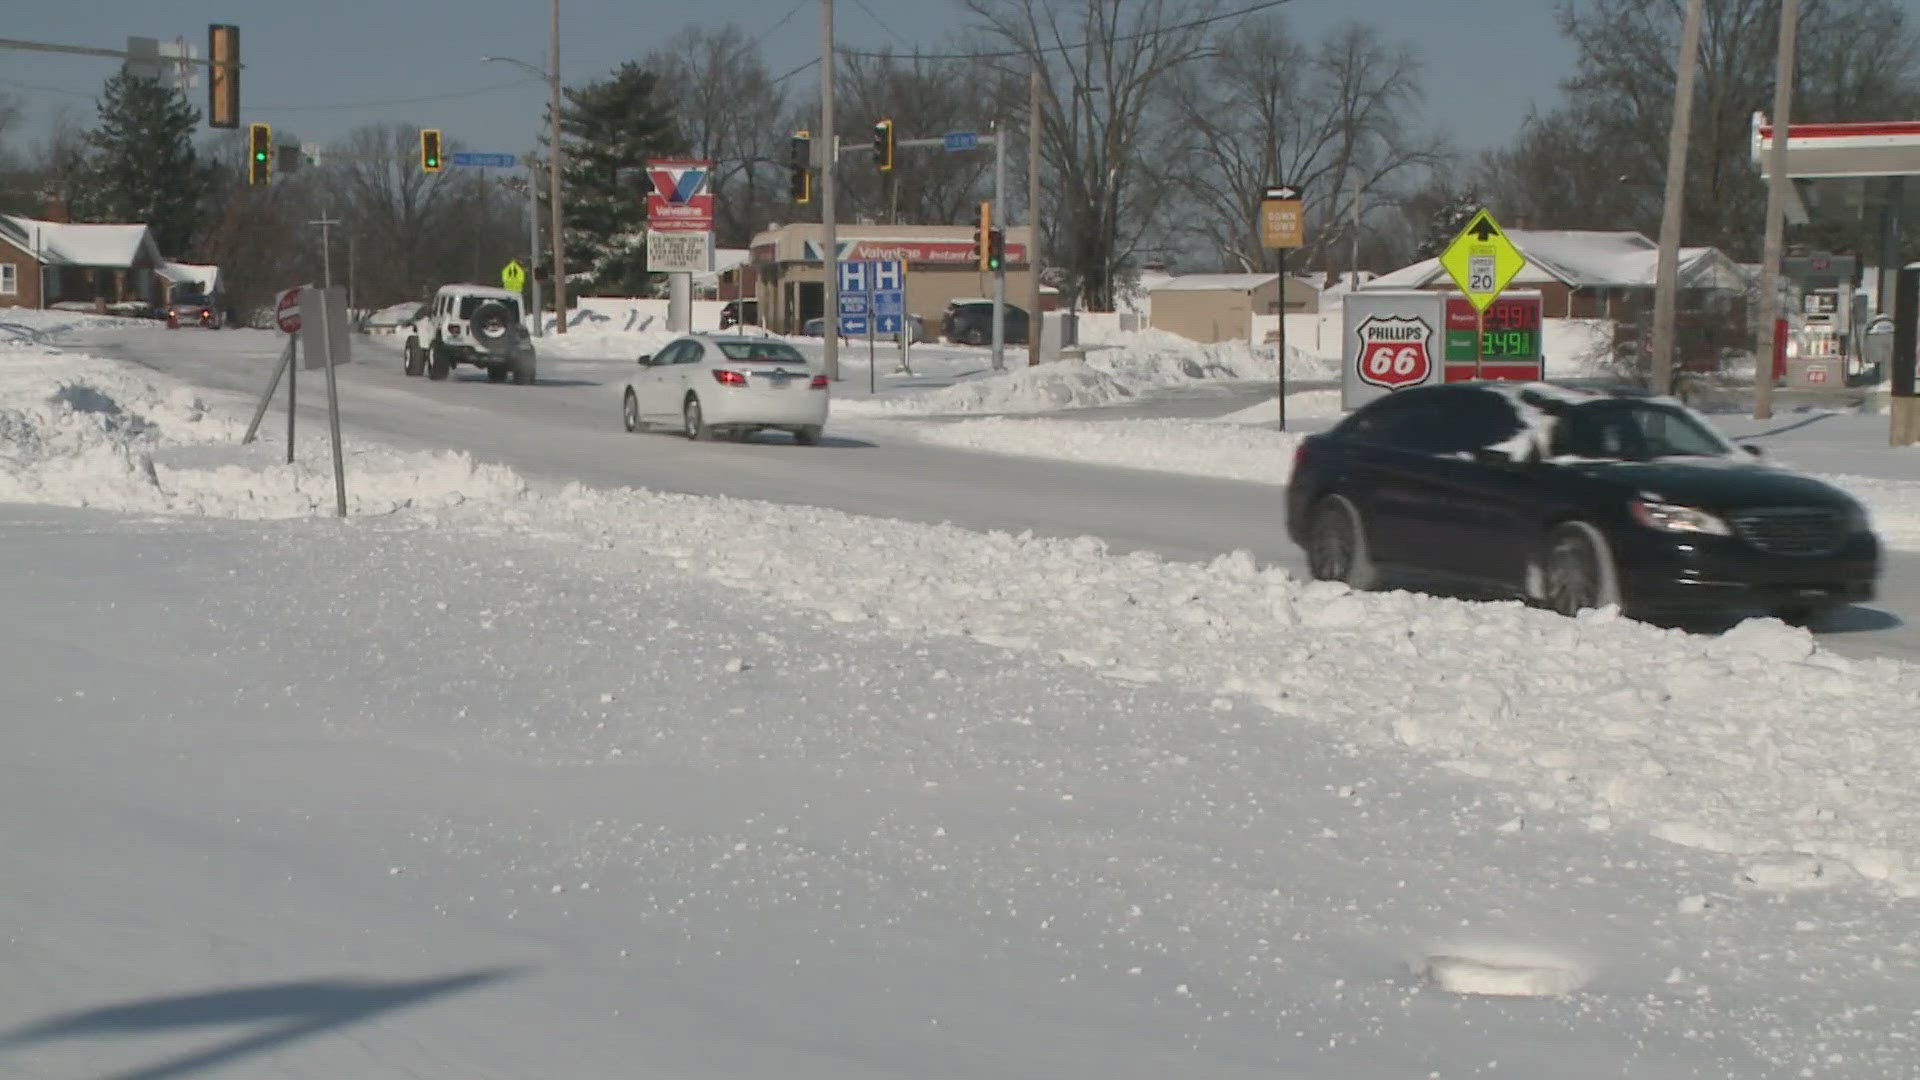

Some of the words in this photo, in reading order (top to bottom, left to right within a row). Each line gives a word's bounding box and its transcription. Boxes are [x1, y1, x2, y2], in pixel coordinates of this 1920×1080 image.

[655, 205, 702, 216] Valvoline
[1269, 222, 1296, 231] TOWN
[842, 262, 865, 291] H
[876, 260, 898, 289] H
[1471, 275, 1492, 289] 20
[1368, 327, 1422, 340] PHILLIPS
[1371, 347, 1418, 374] 66
